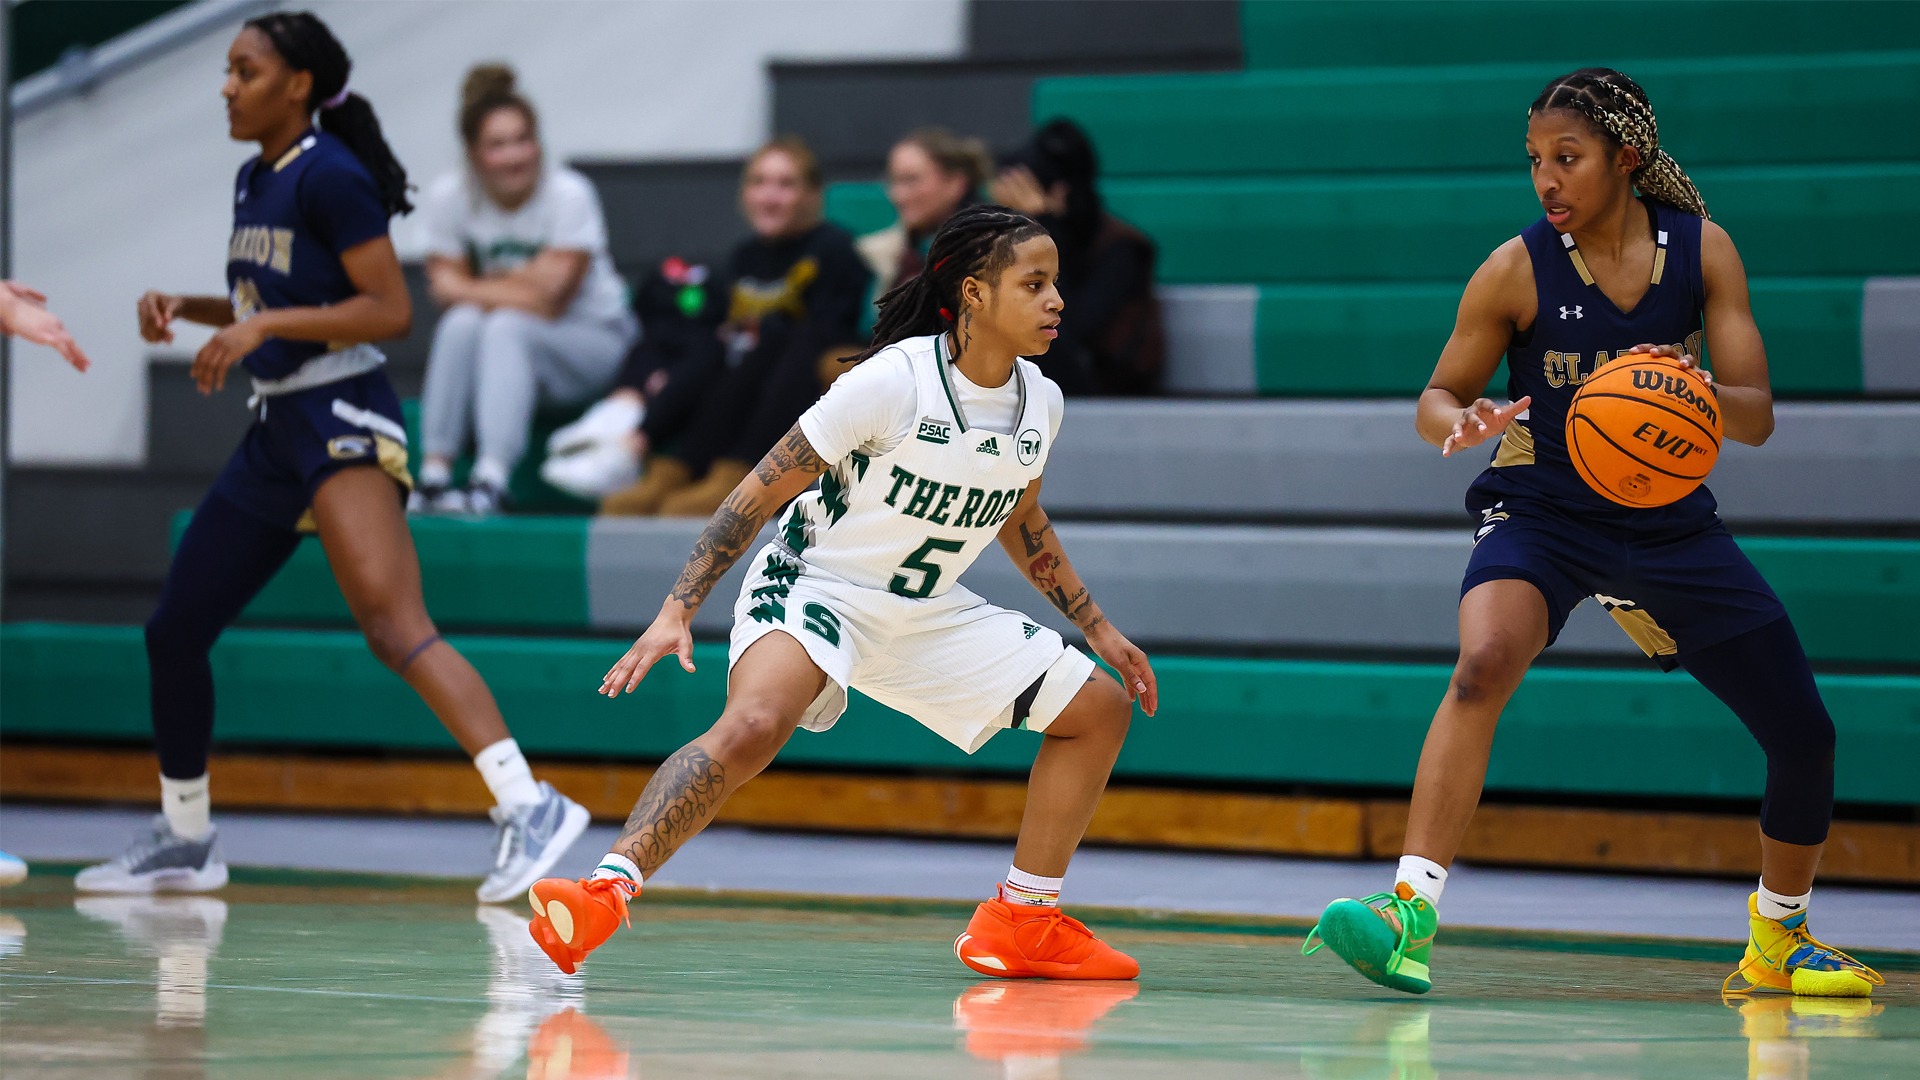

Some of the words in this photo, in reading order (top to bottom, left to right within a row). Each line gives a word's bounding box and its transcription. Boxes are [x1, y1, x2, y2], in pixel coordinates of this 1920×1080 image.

[1632, 370, 1717, 429] Wilson
[918, 422, 951, 439] PSAC
[976, 446, 1000, 457] adidas
[883, 464, 962, 526] THE
[887, 536, 968, 598] 5
